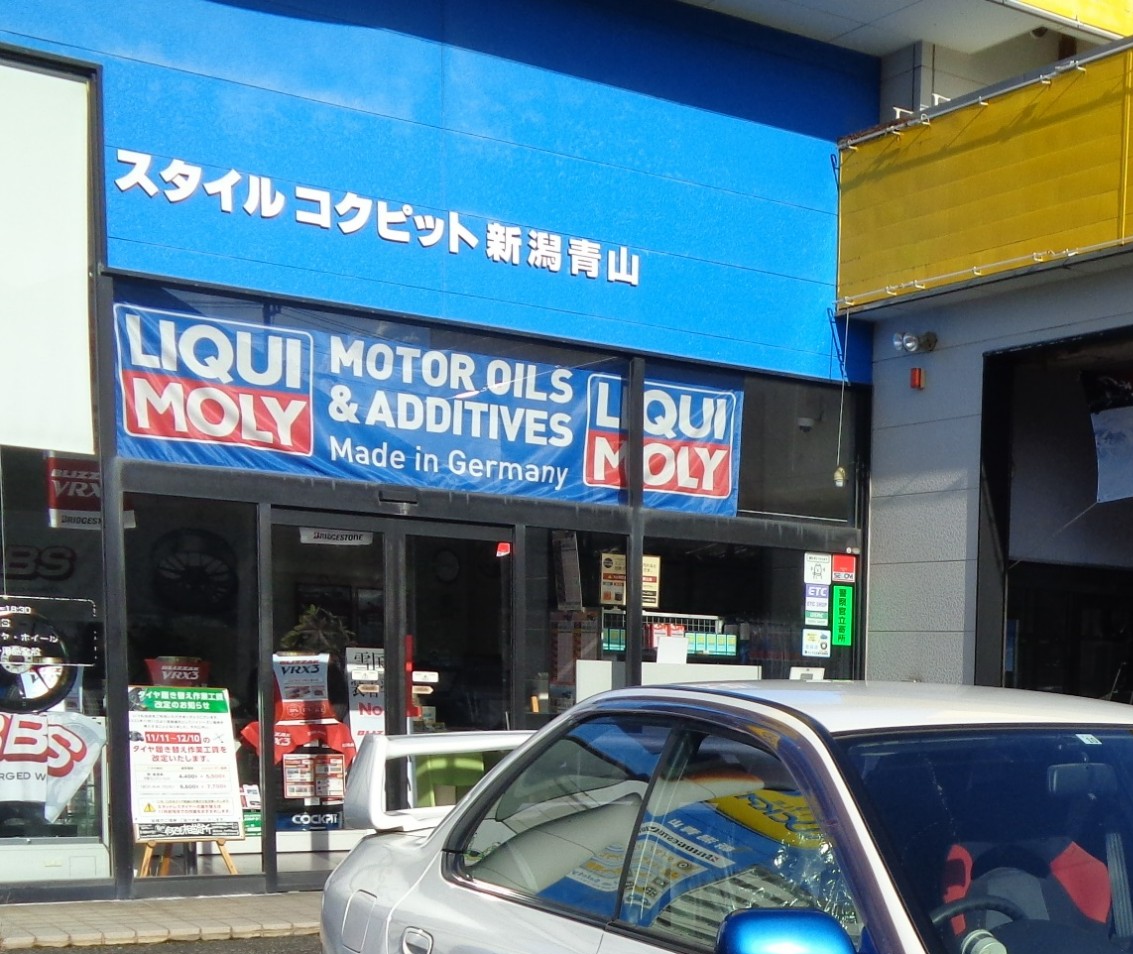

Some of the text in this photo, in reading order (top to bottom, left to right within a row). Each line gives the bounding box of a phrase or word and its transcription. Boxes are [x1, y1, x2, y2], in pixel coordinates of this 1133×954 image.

[114, 149, 640, 286] スタイル コクピット 新潟青山
[125, 313, 302, 389] LIQUI
[330, 335, 574, 404] MOTOR OILS
[132, 376, 308, 447] MOLY
[328, 384, 574, 448] & ADDITIVES
[329, 436, 569, 491] Made in Germany
[808, 586, 828, 597] ETC
[834, 572, 854, 580] SEOM
[161, 671, 200, 680] VRX3
[281, 664, 320, 676] VRX3
